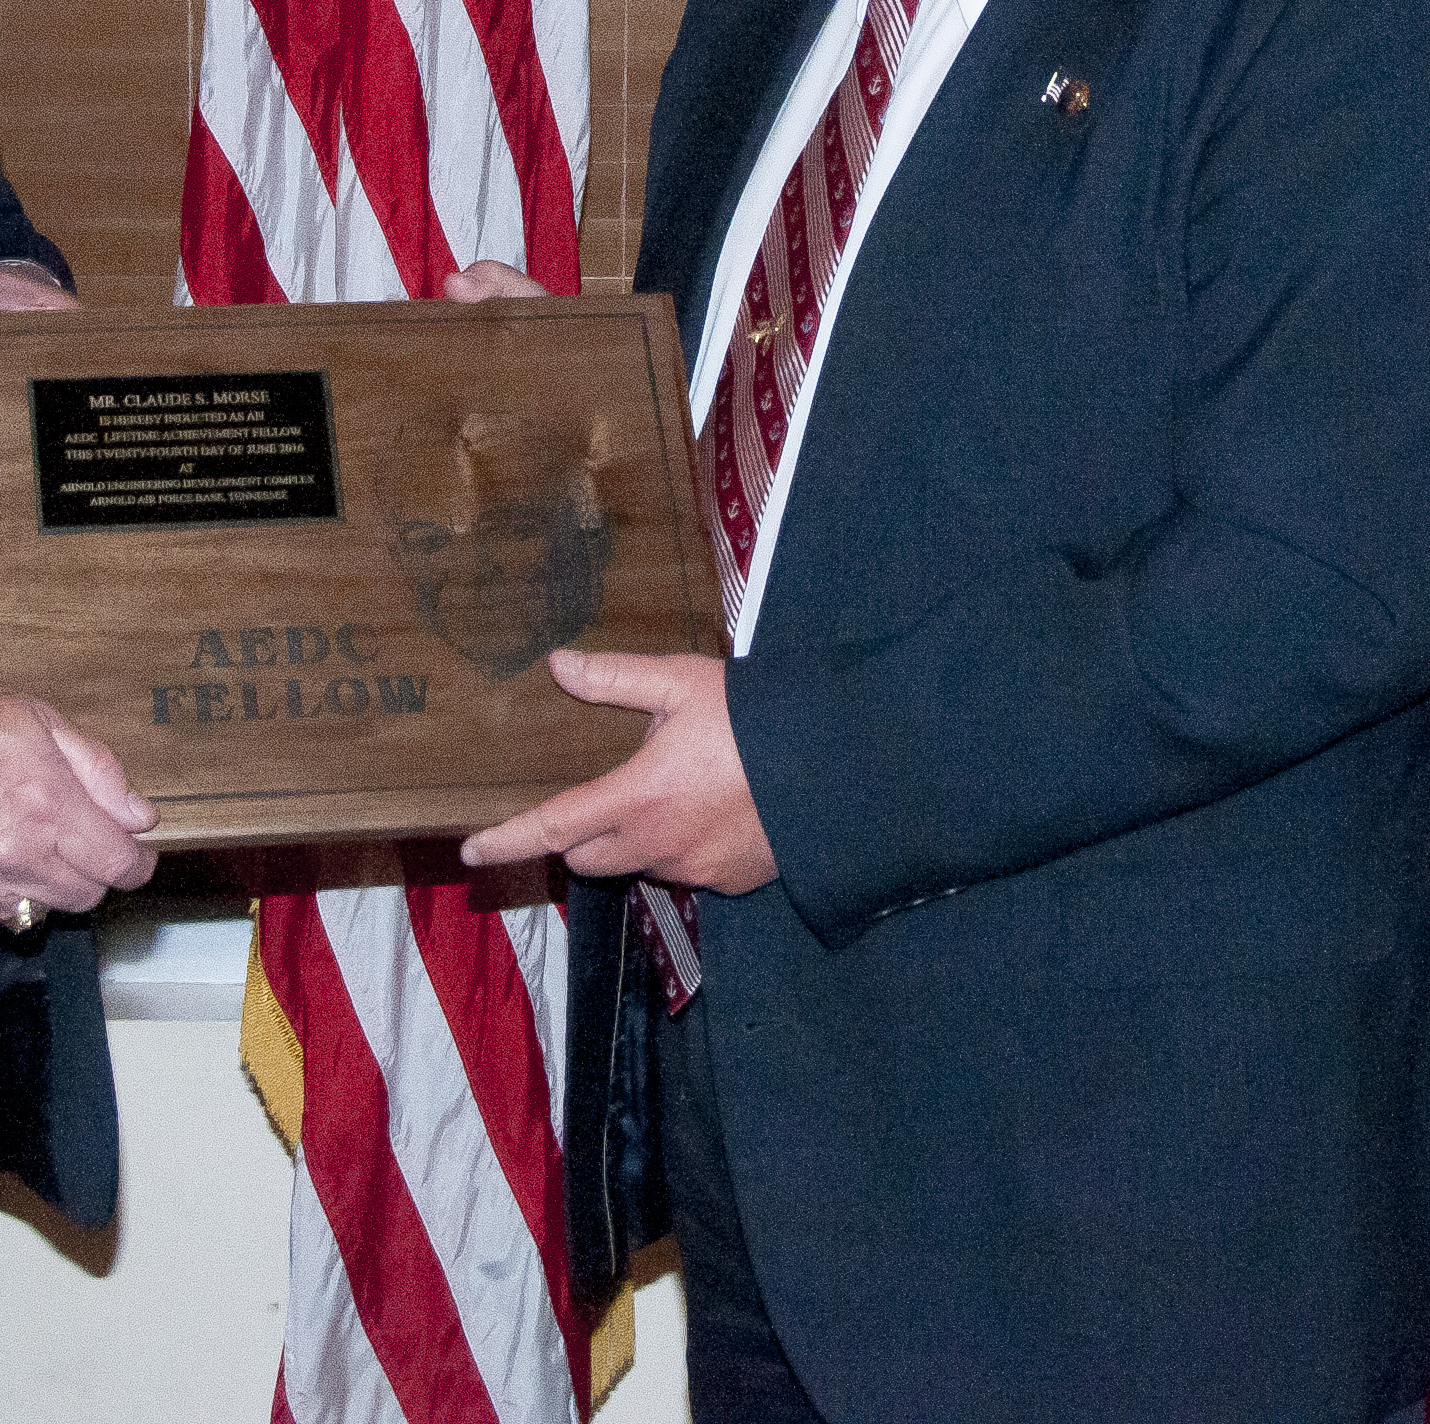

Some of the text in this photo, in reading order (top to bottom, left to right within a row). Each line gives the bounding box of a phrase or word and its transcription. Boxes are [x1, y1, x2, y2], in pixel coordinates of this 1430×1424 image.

[89, 390, 270, 409] MR. CLAUDE S. MORSE
[98, 409, 265, 426] IS HEREBY INDUCTED AS AN
[64, 425, 302, 444] AEDC LIFETIME ACHIEVEMENT FELLOW
[64, 448, 93, 460] THIS
[201, 444, 226, 457] DAY
[227, 443, 244, 456] OF
[246, 443, 277, 455] JUNE
[178, 462, 196, 474] AT
[59, 473, 315, 494] ARNOLD ENGINEERING DEVELOPMENT COMPLEX
[89, 495, 136, 507] ARNOLD
[137, 494, 157, 505] AIR
[158, 492, 195, 504] FORCE
[227, 489, 289, 502] TENNESSEE
[188, 625, 378, 668] AEDC
[151, 675, 428, 726] FELLOW
